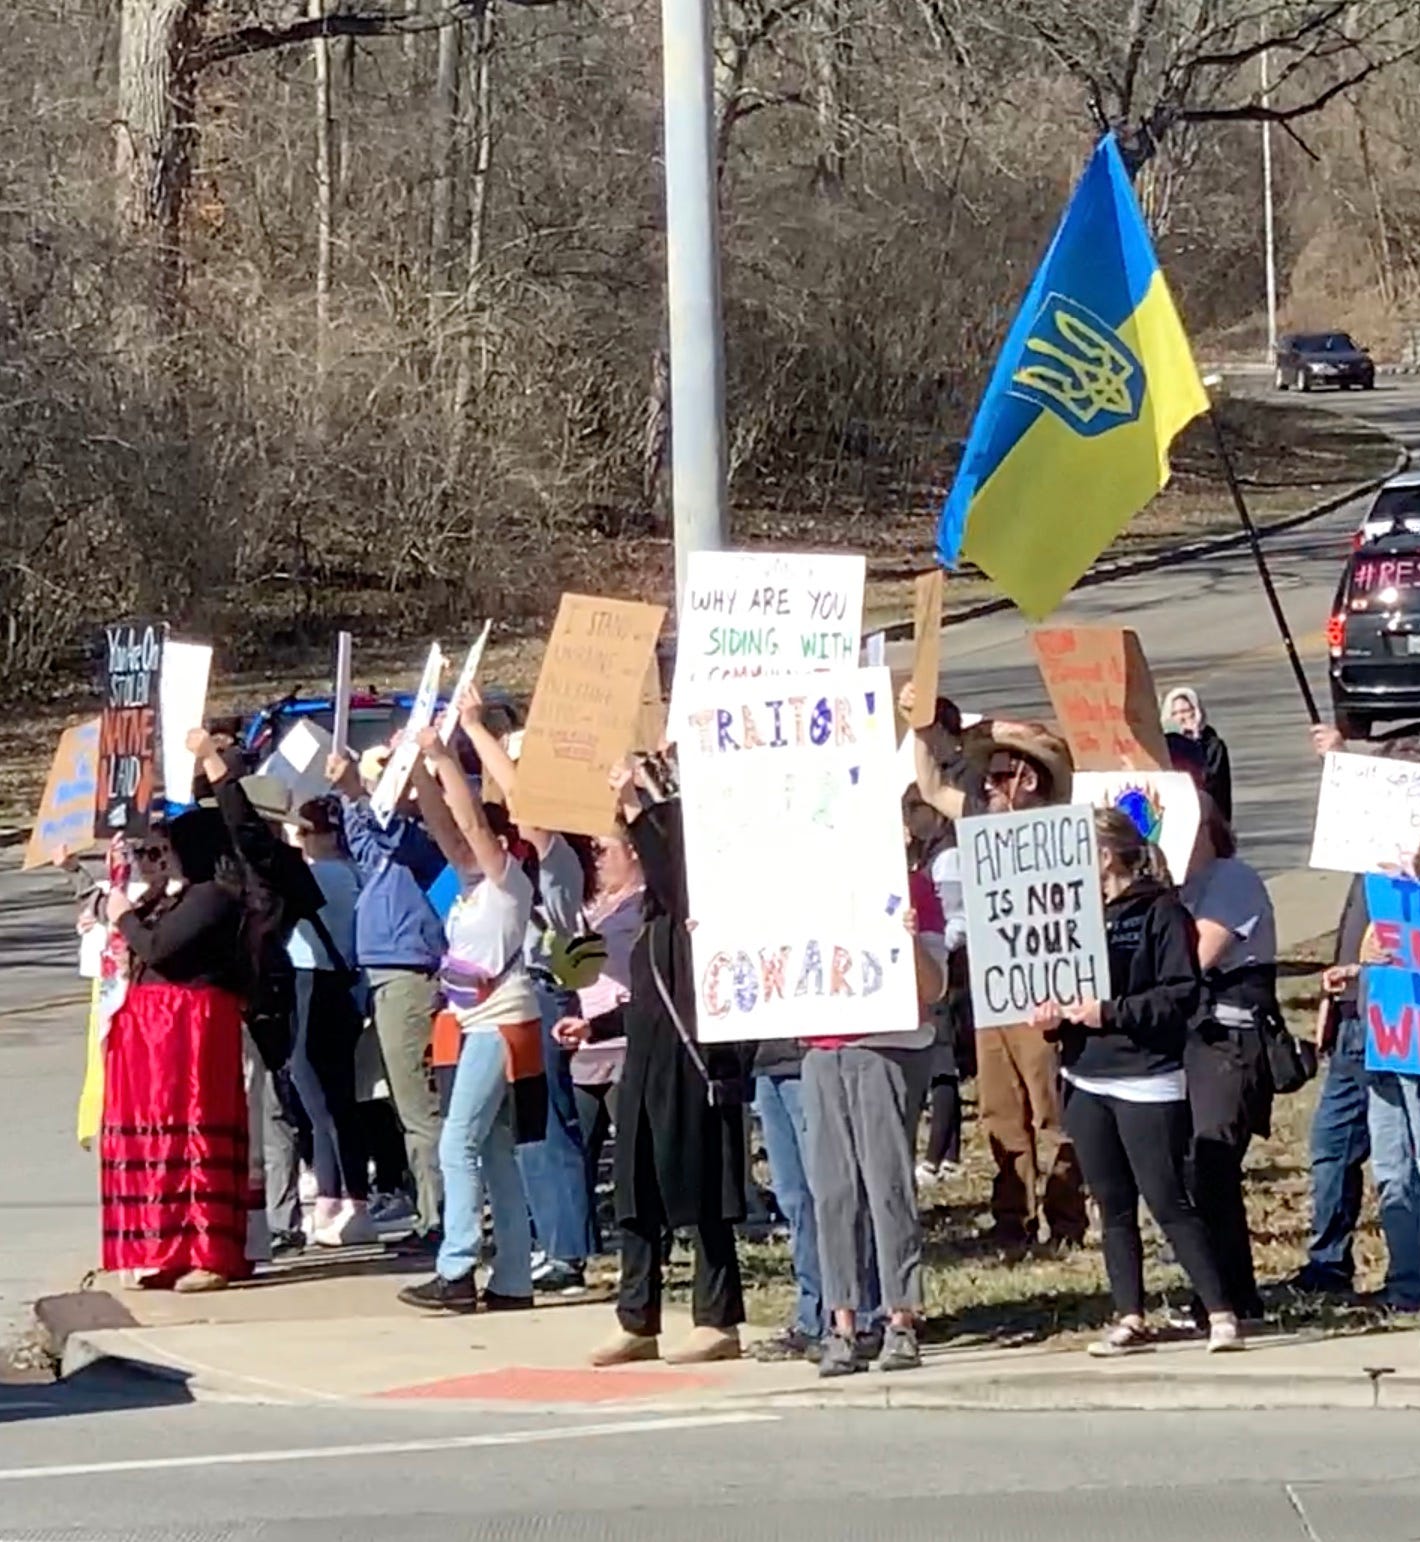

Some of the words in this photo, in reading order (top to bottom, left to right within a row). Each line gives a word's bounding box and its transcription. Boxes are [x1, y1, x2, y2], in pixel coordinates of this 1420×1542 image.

[690, 588, 738, 616] WHY
[748, 586, 792, 616] ARE
[808, 590, 848, 621] YOU
[703, 626, 780, 657] SIDING
[800, 632, 852, 660] WITH
[974, 817, 1092, 886] AMERICA
[985, 888, 1014, 922] IS
[1027, 879, 1084, 917] NOT
[997, 919, 1082, 958] YOUR
[984, 954, 1098, 1014] COUCH
